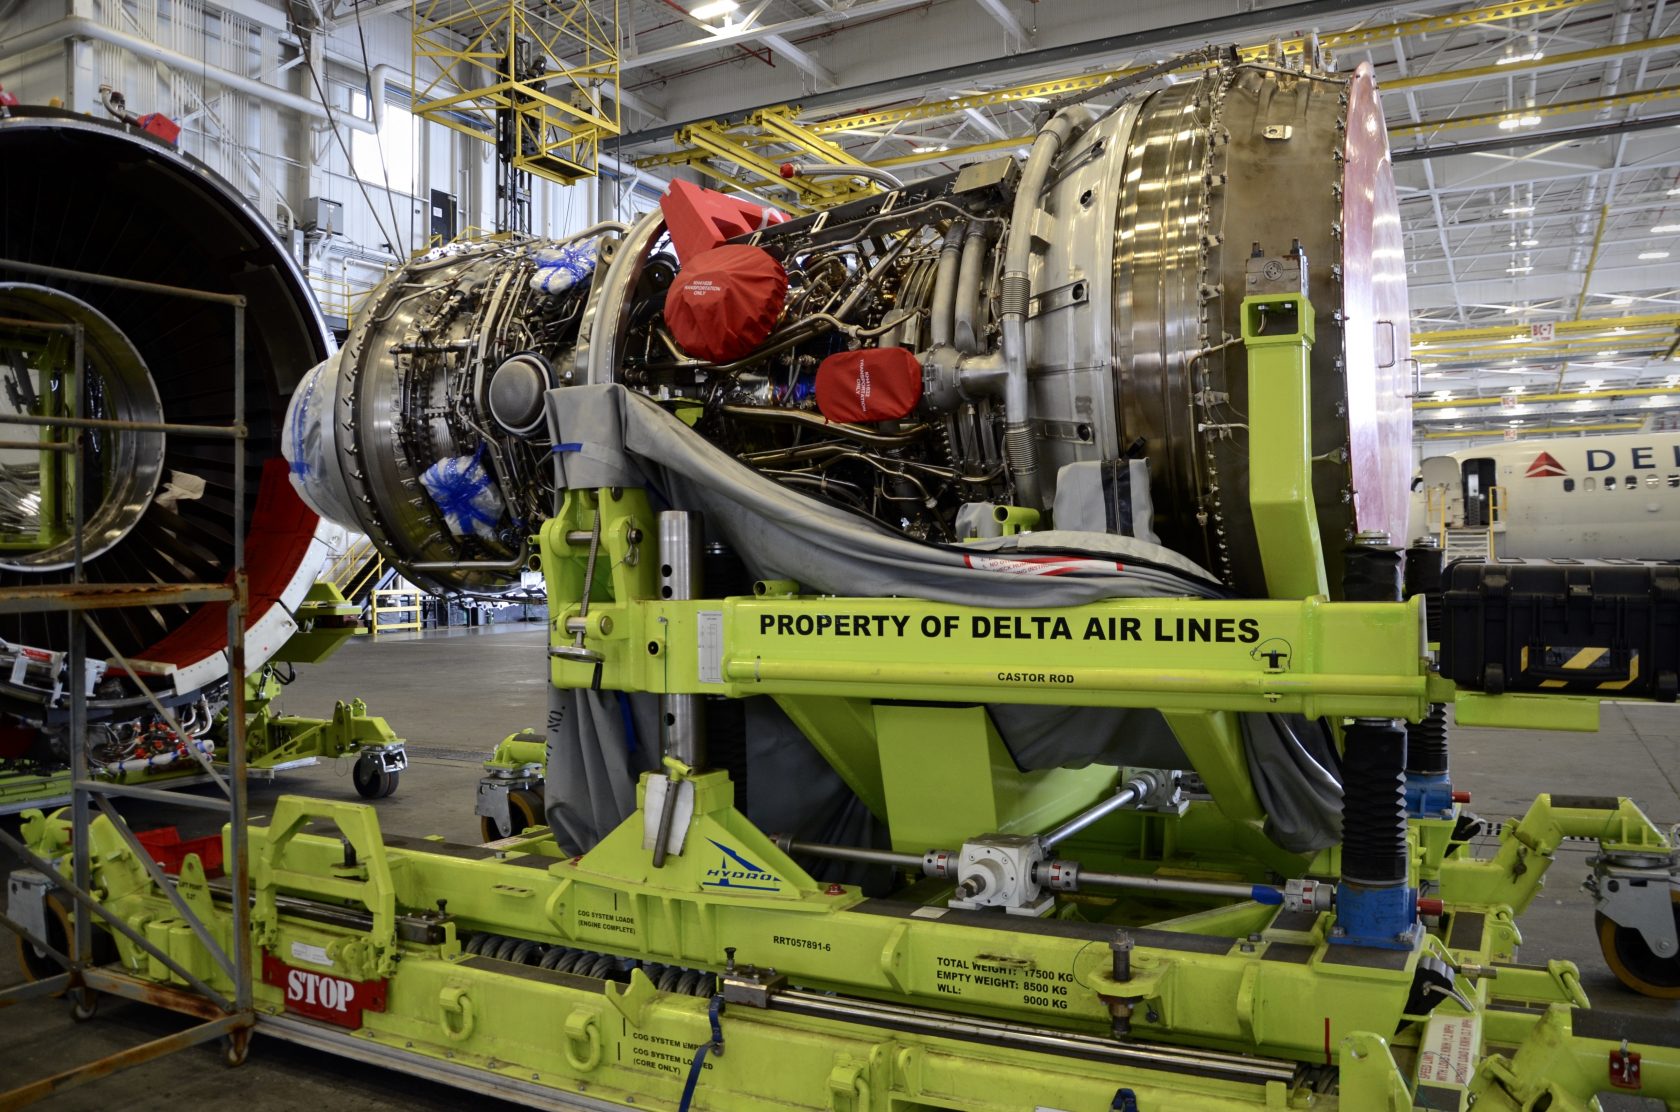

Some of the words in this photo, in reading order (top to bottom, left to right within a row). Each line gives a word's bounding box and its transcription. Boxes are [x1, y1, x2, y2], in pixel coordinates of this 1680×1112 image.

[760, 614, 911, 637] PROPERTY
[920, 615, 960, 638] OF
[971, 616, 1073, 640] DELTA
[1082, 617, 1143, 641] AIR
[1154, 618, 1260, 643] LINES
[997, 672, 1045, 682] CASTOR
[1049, 673, 1074, 683] ROD
[706, 869, 772, 881] HYDRO
[577, 909, 590, 917] COG
[591, 912, 614, 921] SYSTEM
[577, 919, 602, 929] (ENGINE
[602, 923, 636, 935] COMPLETE)
[773, 935, 831, 951] RRT057891-6
[937, 957, 970, 969] TOTAL
[972, 962, 1017, 976] WEIGHT:
[1058, 972, 1074, 983] KG
[287, 969, 355, 1012] STOP
[937, 970, 971, 982] EMPTY
[974, 975, 1019, 990] WEIGHT:
[1023, 981, 1049, 993] 8500
[1052, 985, 1068, 996] KG
[937, 983, 962, 995] WLL:
[1023, 994, 1049, 1007] 9000
[1052, 999, 1068, 1010] KG
[633, 1032, 649, 1041] COG
[650, 1035, 681, 1048] SYSTEM
[682, 1041, 702, 1051] EMP
[633, 1047, 649, 1056] COG
[650, 1050, 681, 1064] SYSTEM
[682, 1057, 714, 1070] LOED
[633, 1058, 657, 1069] (CORE
[657, 1063, 681, 1076] ONLY)
